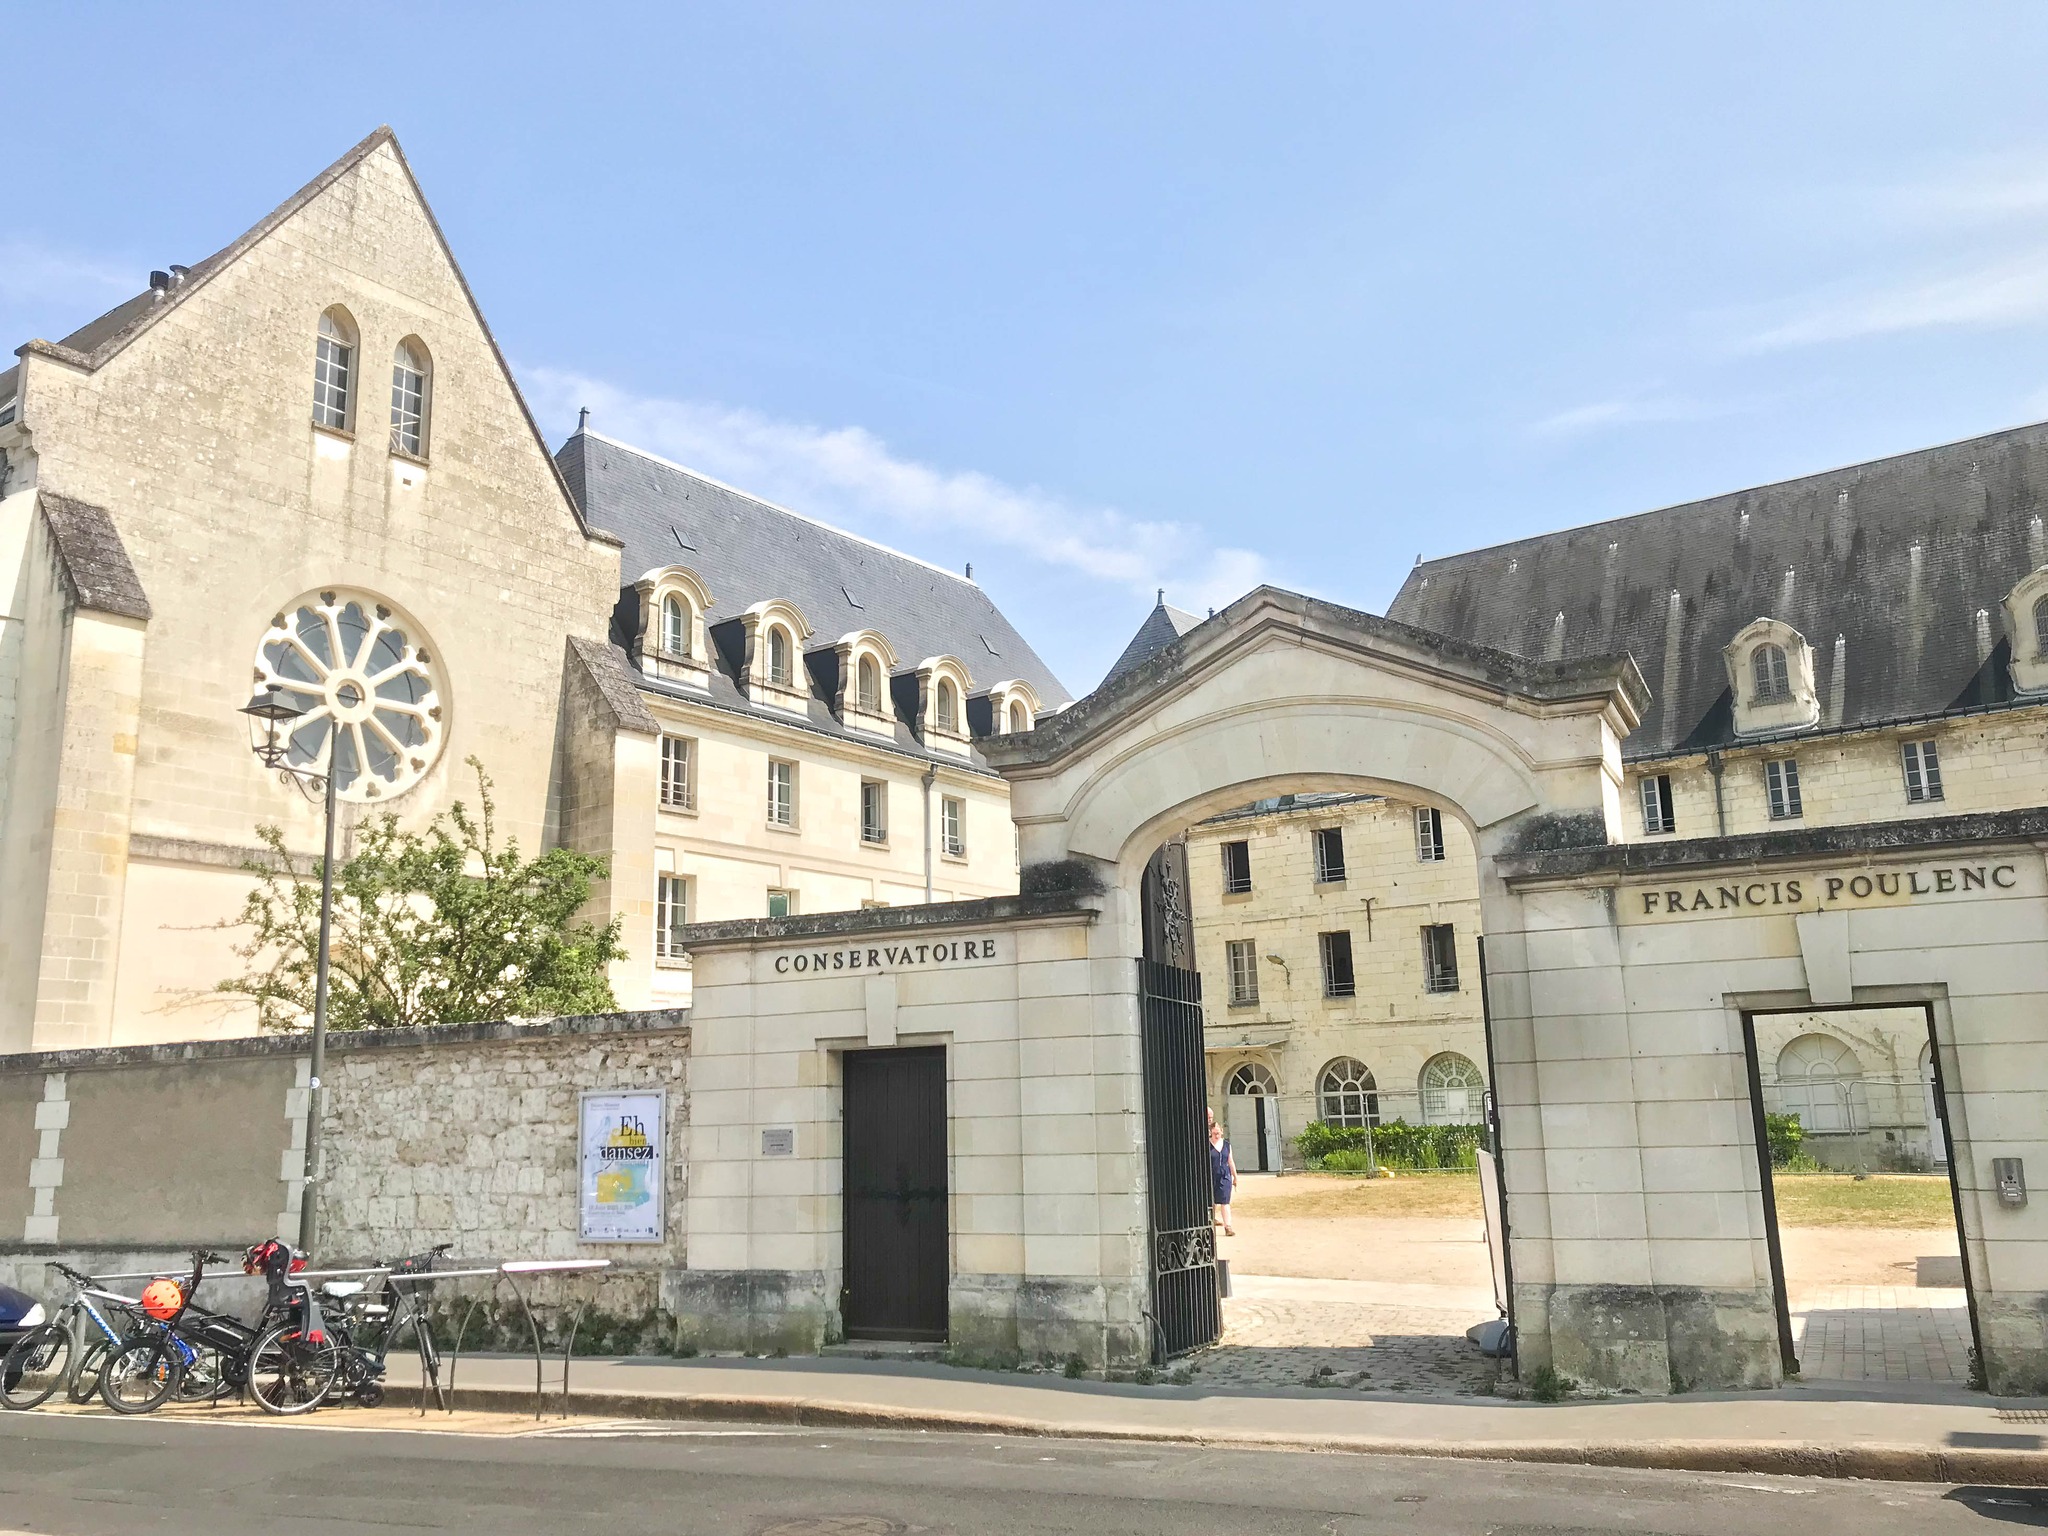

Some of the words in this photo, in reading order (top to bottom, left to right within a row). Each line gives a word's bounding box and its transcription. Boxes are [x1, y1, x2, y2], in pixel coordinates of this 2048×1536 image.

[1642, 880, 1802, 915] FRANCIS
[1825, 865, 2017, 901] POULENC
[775, 939, 996, 973] CONSERVATOIRE
[620, 1115, 646, 1136] Eh
[600, 1145, 651, 1160] dansez
